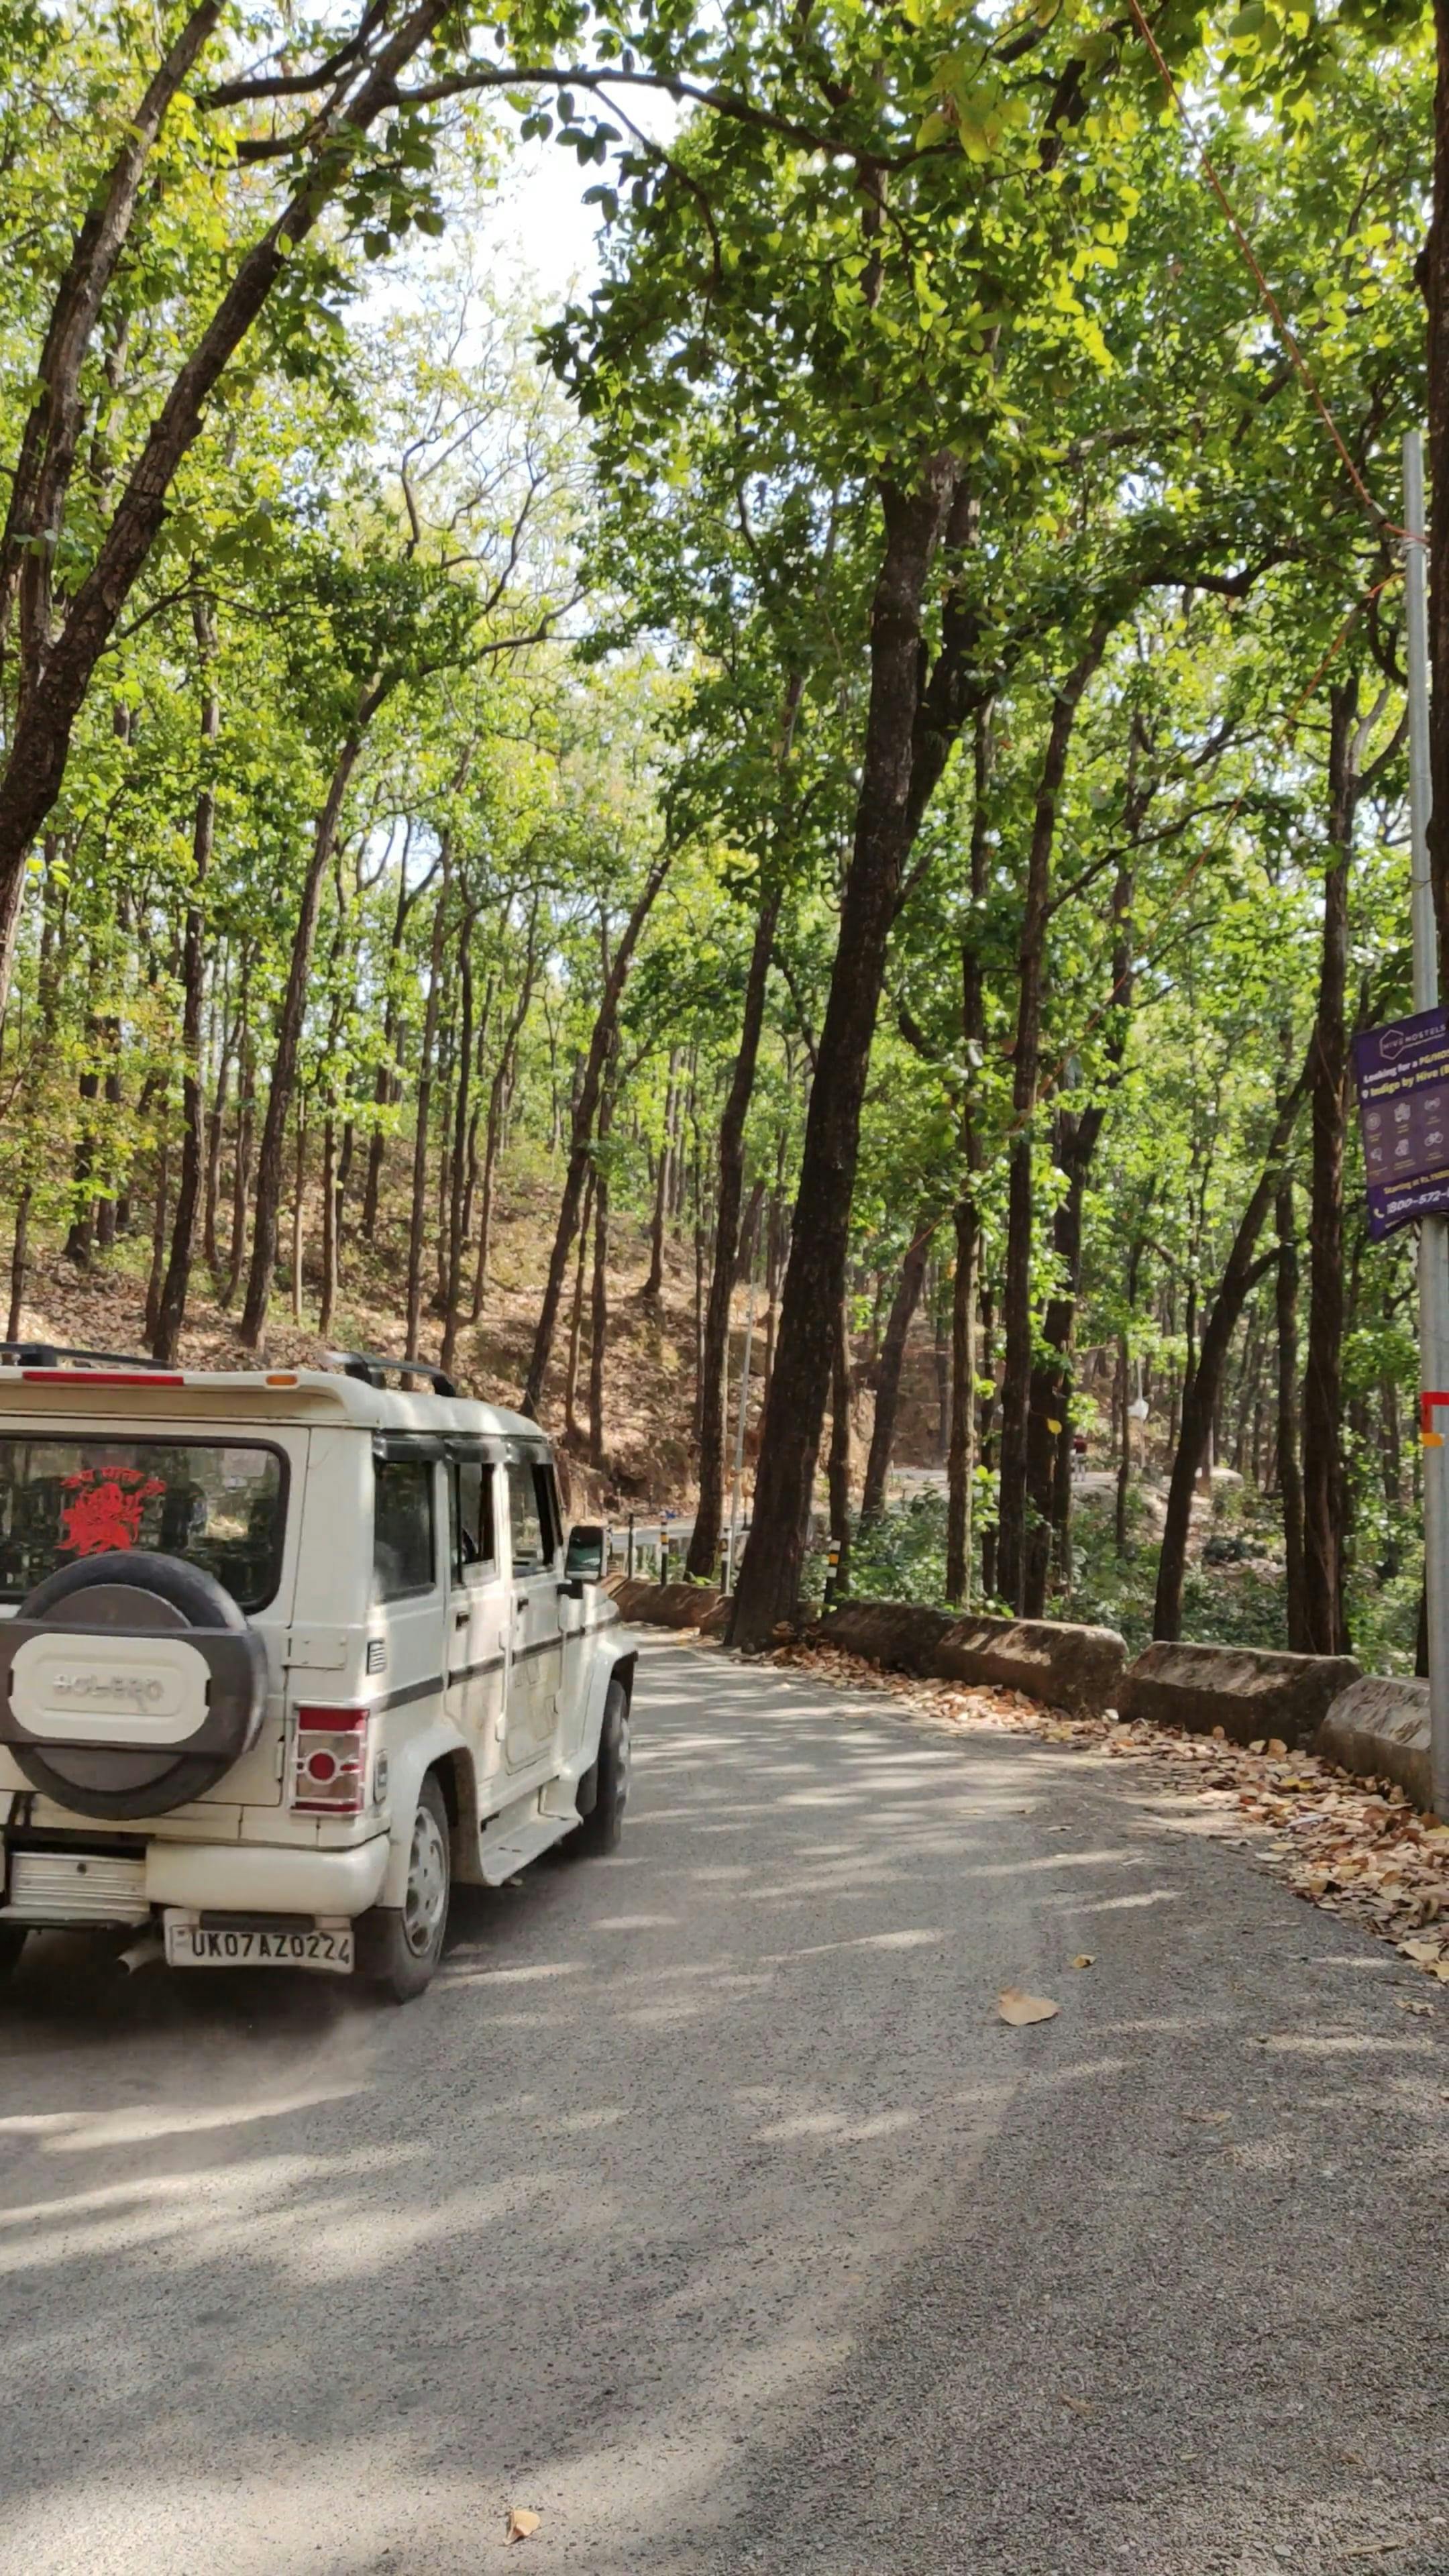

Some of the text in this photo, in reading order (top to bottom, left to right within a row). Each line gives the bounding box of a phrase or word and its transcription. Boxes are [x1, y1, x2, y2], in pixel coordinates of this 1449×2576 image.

[1405, 1024, 1446, 1042] HOSTELS
[1363, 1067, 1397, 1084] Looking
[1397, 1063, 1412, 1073] for
[1401, 1077, 1415, 1088] by
[1416, 1069, 1439, 1083] Hive
[1386, 1187, 1449, 1215] 1800-572-
[54, 1674, 164, 1702] BOLERO
[191, 1931, 350, 1965] UK07AZ0224
